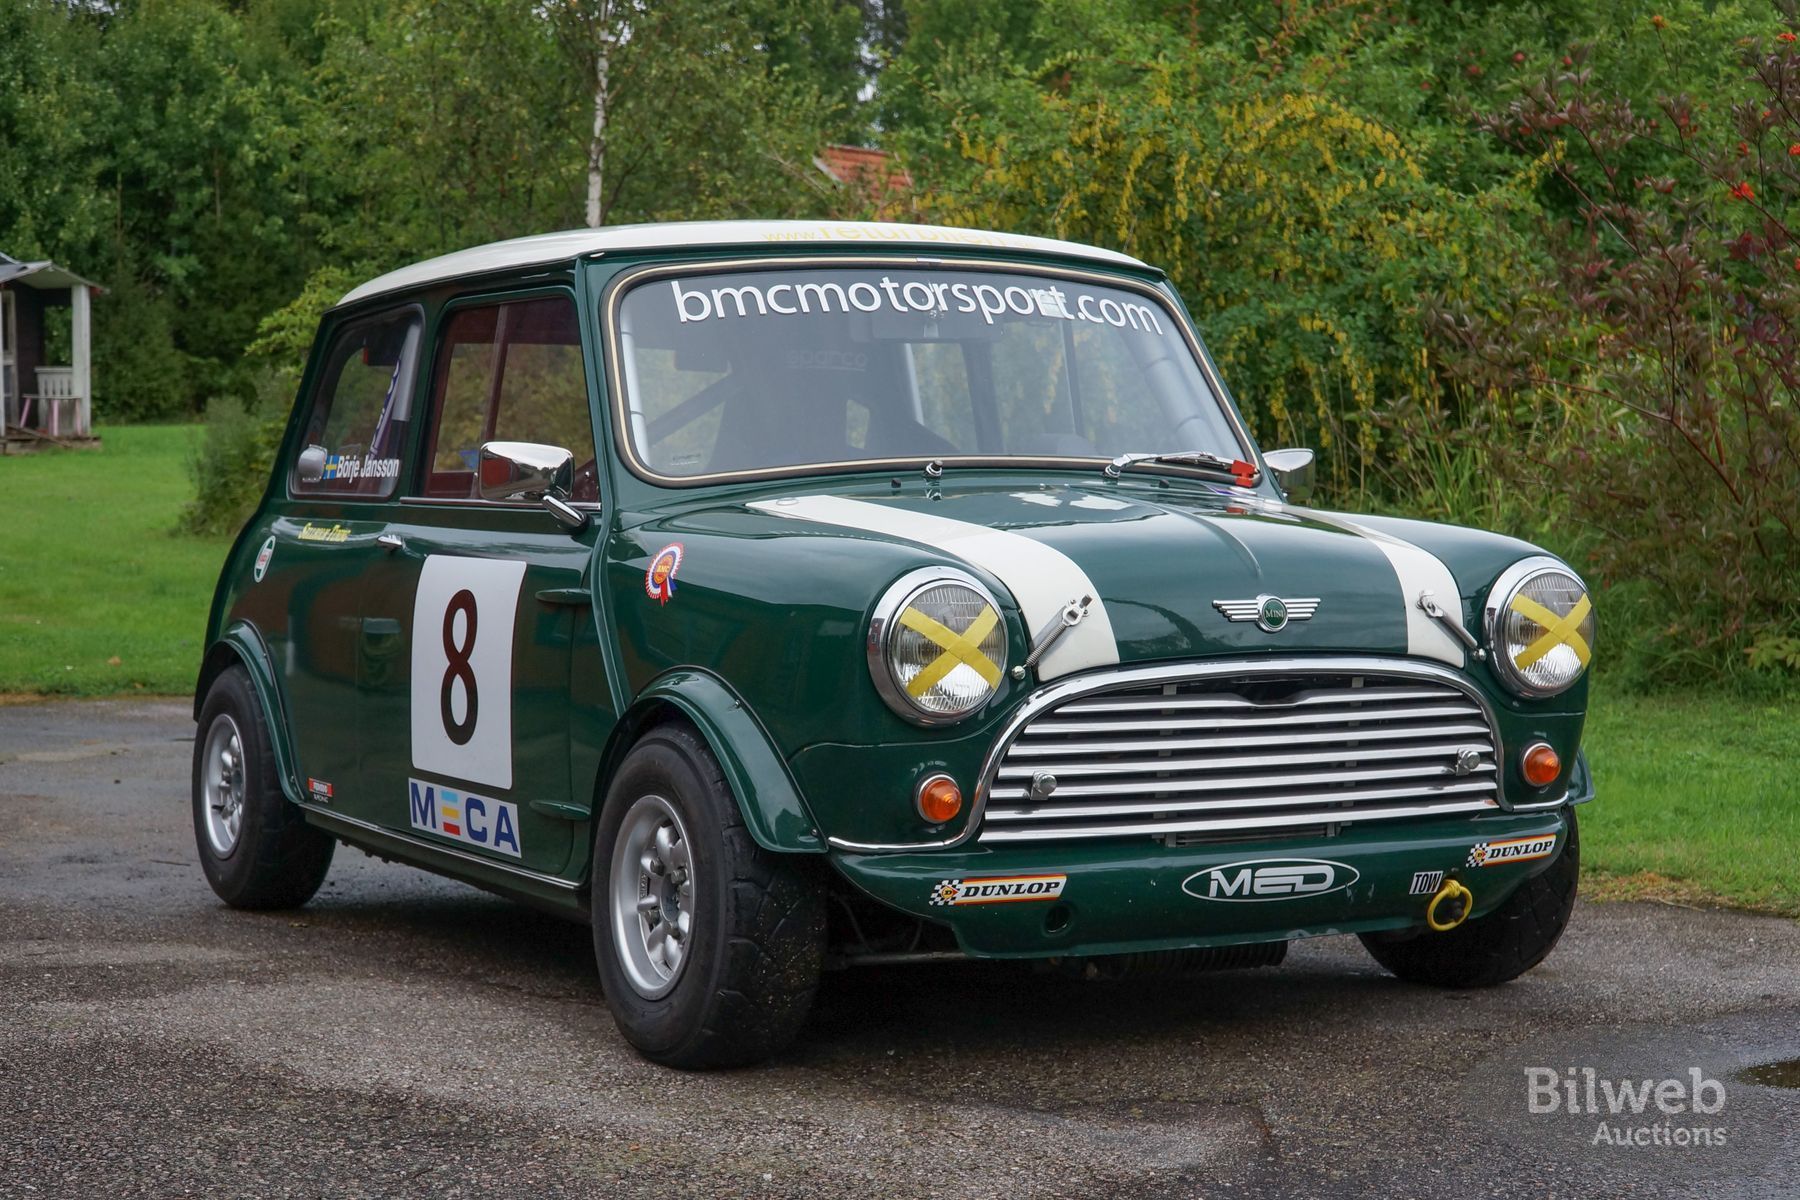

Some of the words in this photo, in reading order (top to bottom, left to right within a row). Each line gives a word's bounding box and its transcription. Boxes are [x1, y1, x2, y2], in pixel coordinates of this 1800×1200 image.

[672, 277, 1164, 335] bmcmotorsport.com
[336, 454, 360, 483] Börje
[361, 454, 400, 478] Jansson
[1265, 609, 1284, 618] MINI
[441, 589, 478, 746] 8
[411, 782, 519, 853] MECA
[1489, 840, 1552, 858] DUNLOP
[962, 882, 1060, 897] DUNLOP
[1209, 865, 1334, 897] MED
[1413, 873, 1441, 893] TOW
